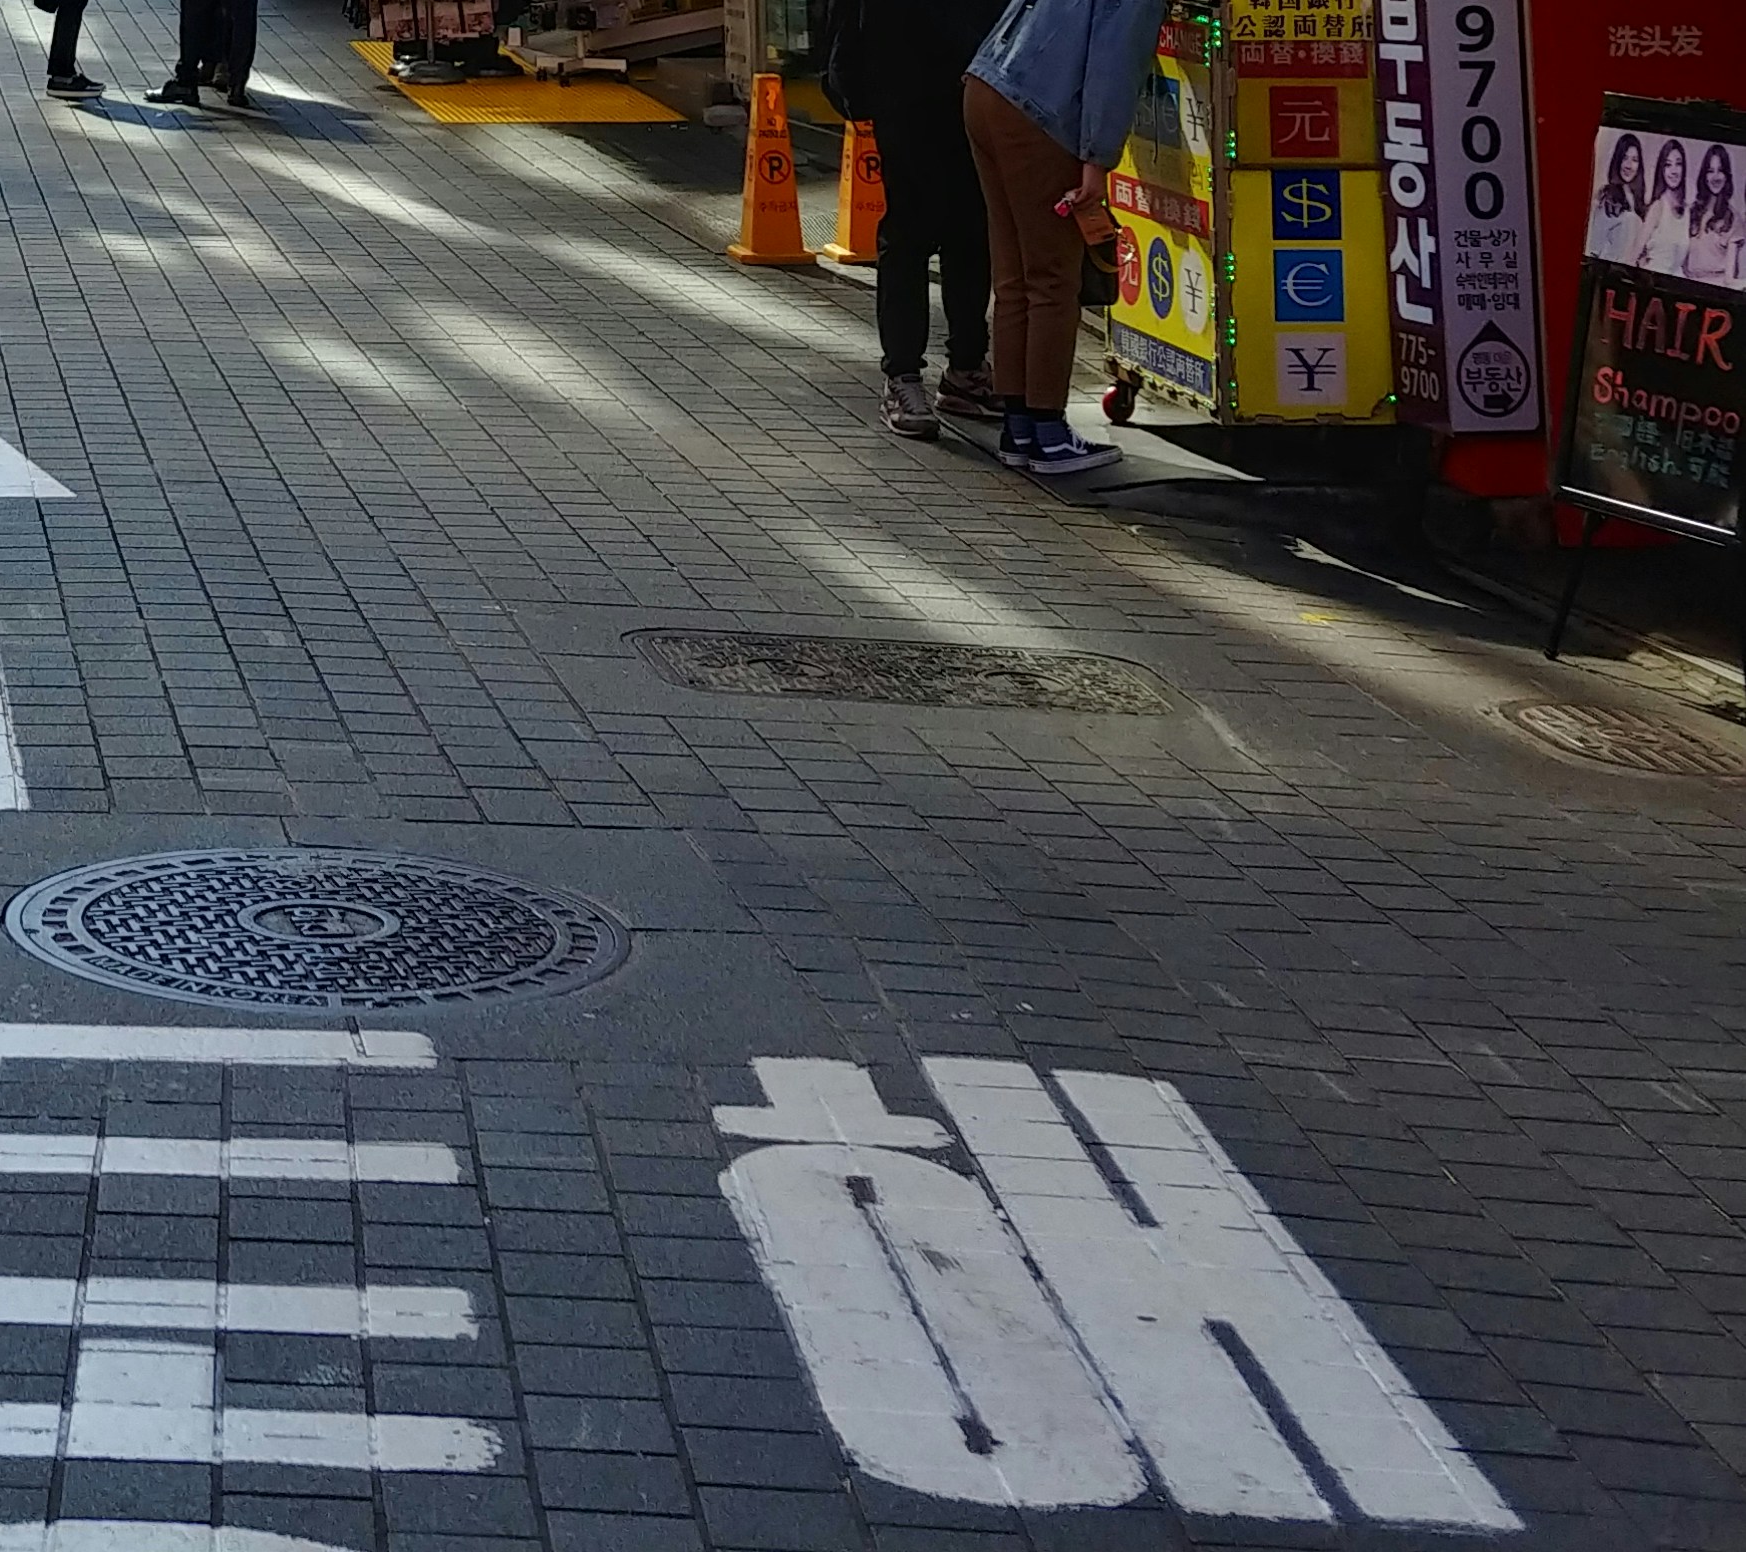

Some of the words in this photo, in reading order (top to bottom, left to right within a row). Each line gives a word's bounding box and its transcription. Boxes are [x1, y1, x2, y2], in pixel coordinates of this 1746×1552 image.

[1605, 288, 1734, 372] HAIR
[1401, 367, 1440, 402] 9700
[1594, 365, 1741, 444] Shampoo
[90, 955, 164, 986] MADE
[169, 977, 206, 994] IN
